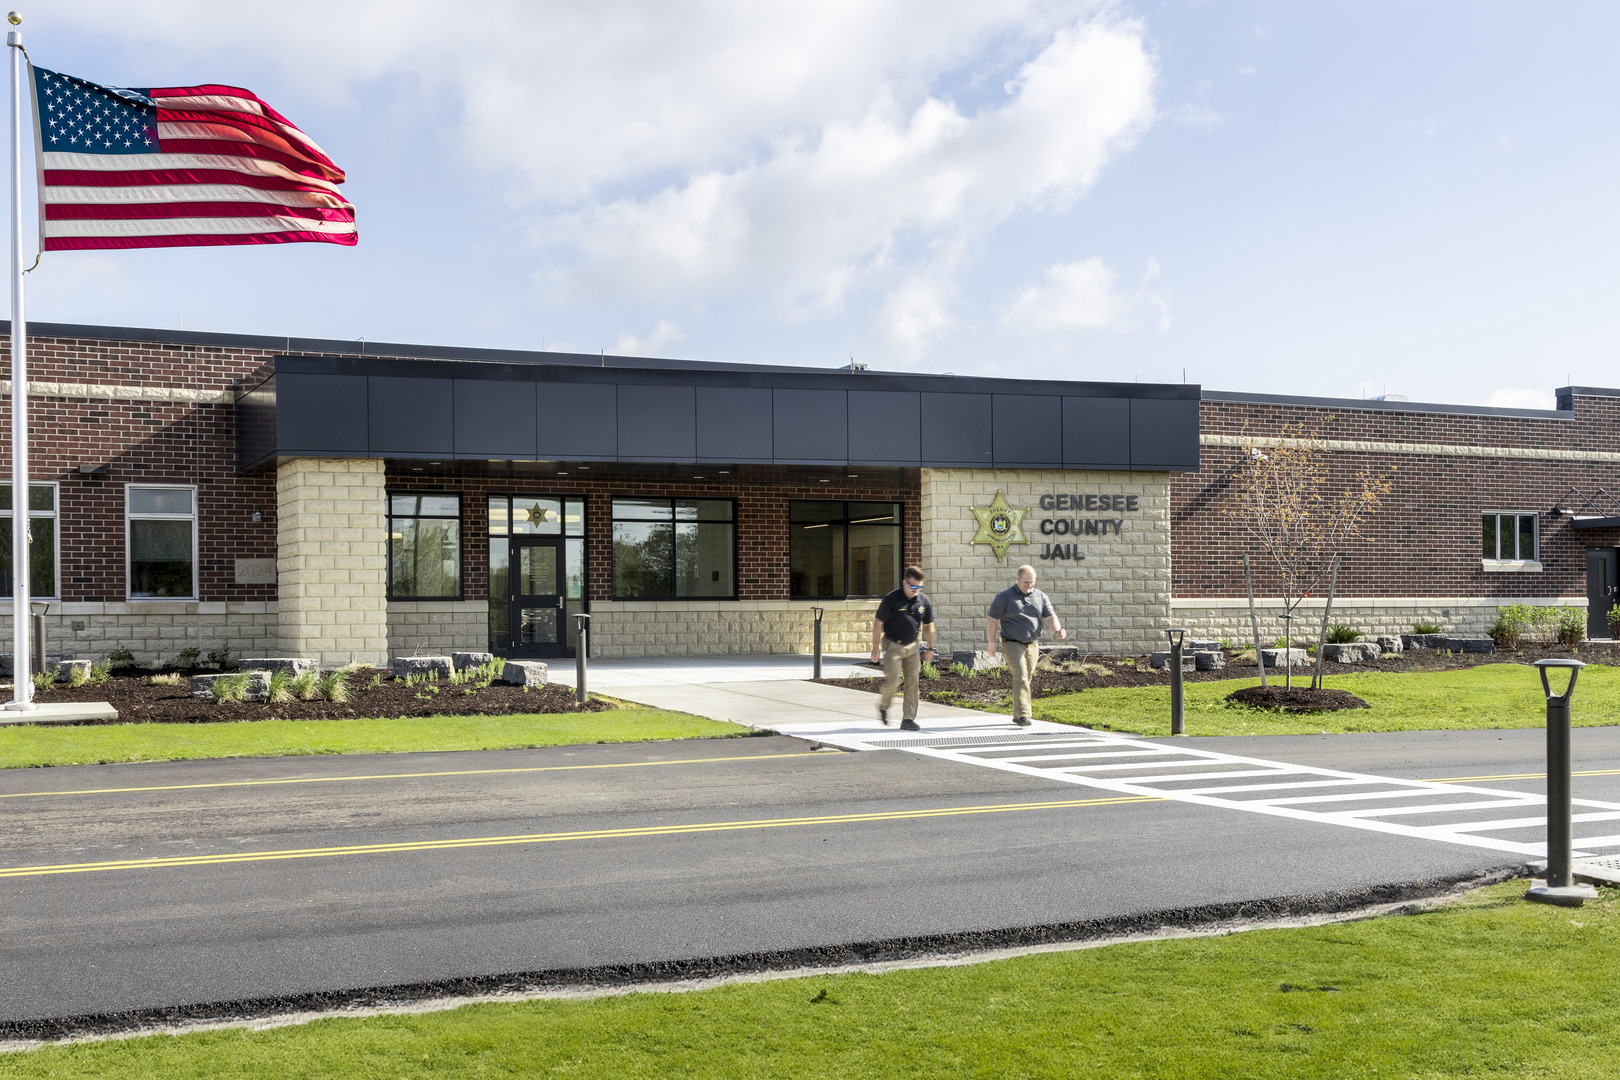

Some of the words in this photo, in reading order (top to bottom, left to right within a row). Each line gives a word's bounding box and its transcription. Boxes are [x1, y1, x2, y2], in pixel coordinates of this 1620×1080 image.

[1040, 494, 1138, 512] GENESEE
[1040, 519, 1124, 536] COUNTY
[1040, 543, 1085, 560] JAIL
[237, 563, 274, 578] 2024
